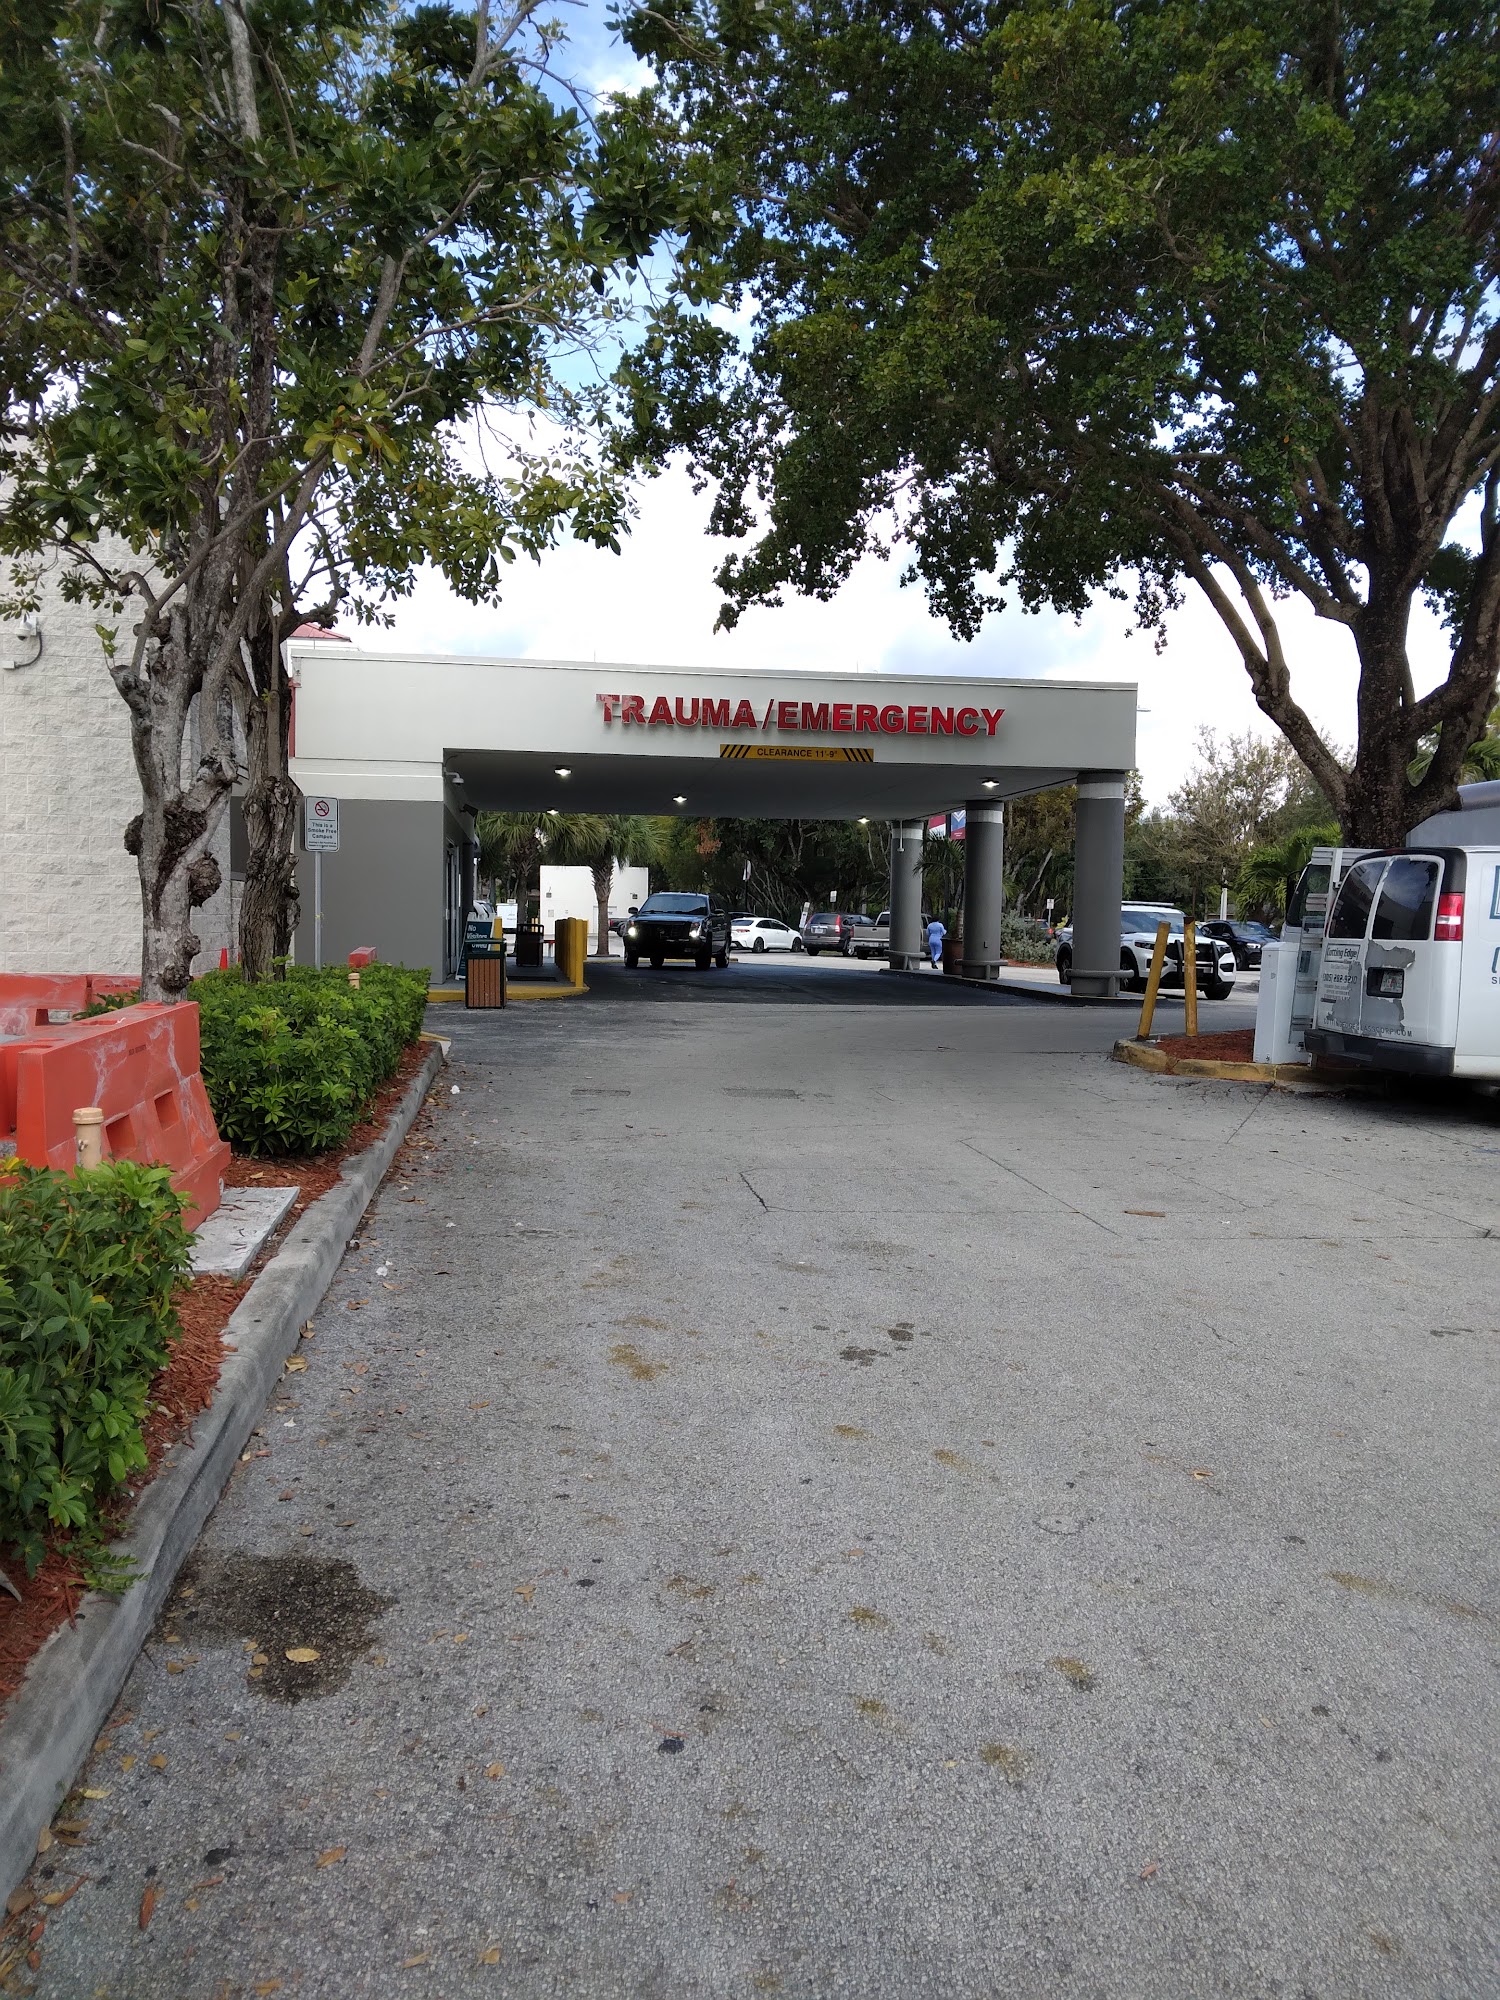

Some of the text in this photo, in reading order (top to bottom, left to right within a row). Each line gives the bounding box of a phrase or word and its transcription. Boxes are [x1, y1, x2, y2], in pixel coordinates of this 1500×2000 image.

[596, 694, 1006, 736] TRAUMA/EMERGENCY
[757, 748, 812, 757] CLEARANCE
[467, 924, 477, 932] No
[1344, 948, 1358, 960] Edge
